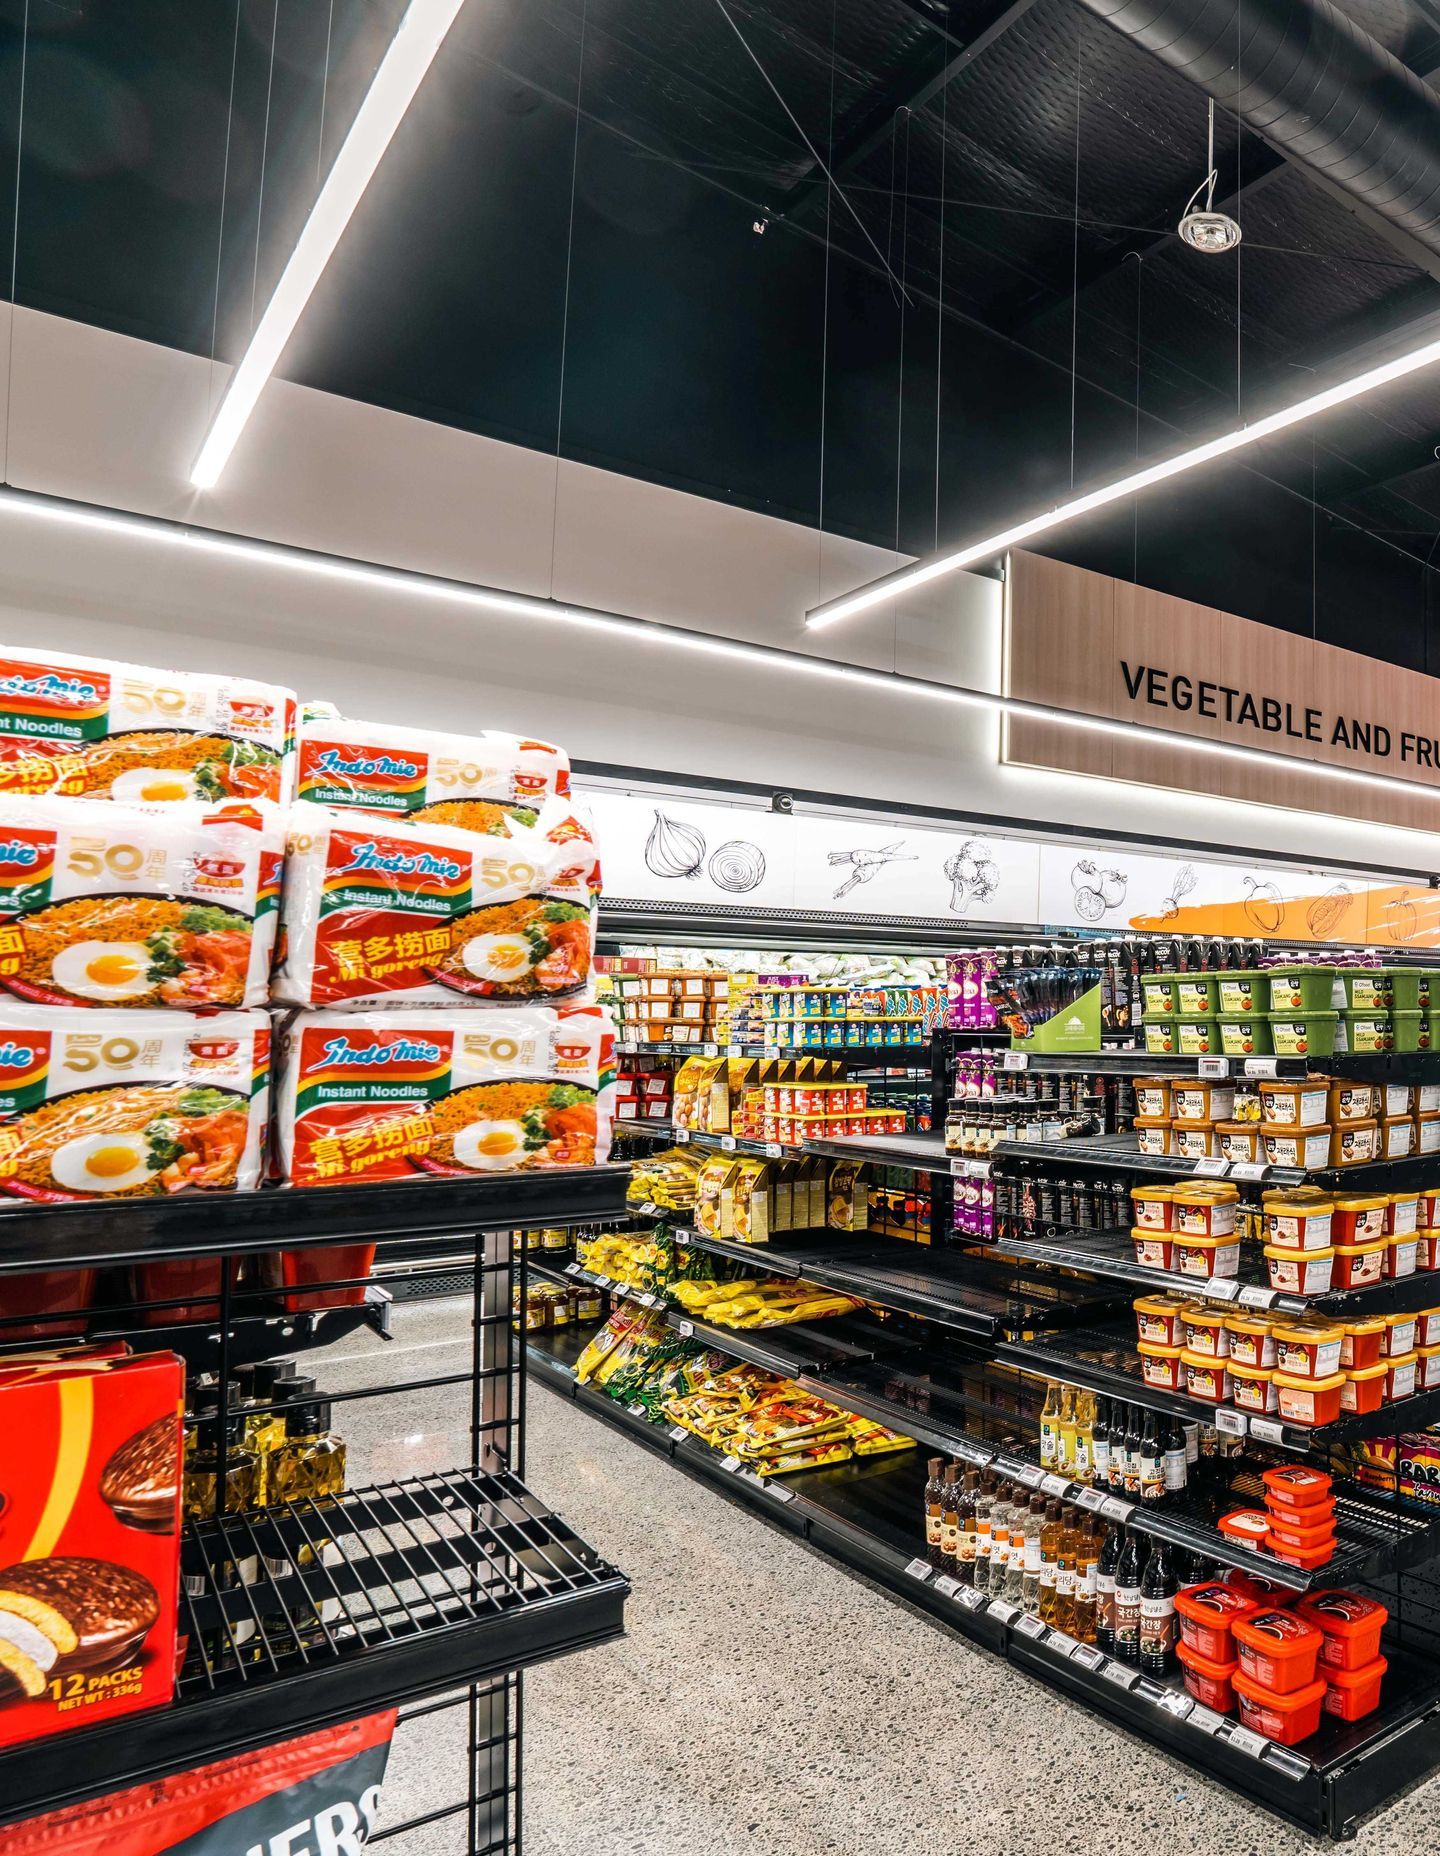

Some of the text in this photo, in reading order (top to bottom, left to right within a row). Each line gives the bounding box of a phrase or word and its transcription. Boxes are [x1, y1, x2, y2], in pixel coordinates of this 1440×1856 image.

[1120, 661, 1323, 742] VEGETABLE
[1331, 716, 1391, 757] AND
[15, 718, 83, 738] Noodles
[315, 787, 408, 807] Instant Noodles
[344, 889, 450, 912] Instant Noodles
[371, 952, 443, 979] goreng
[306, 1035, 441, 1073] Indomie
[318, 1085, 428, 1098] Instant Noodles
[350, 1139, 431, 1173] goreng
[1117, 1606, 1141, 1617] 국간장
[1140, 1616, 1162, 1630] 국간장
[48, 1666, 143, 1700] 12 PACKS
[57, 1696, 82, 1712] NET
[113, 1682, 143, 1701] 336g
